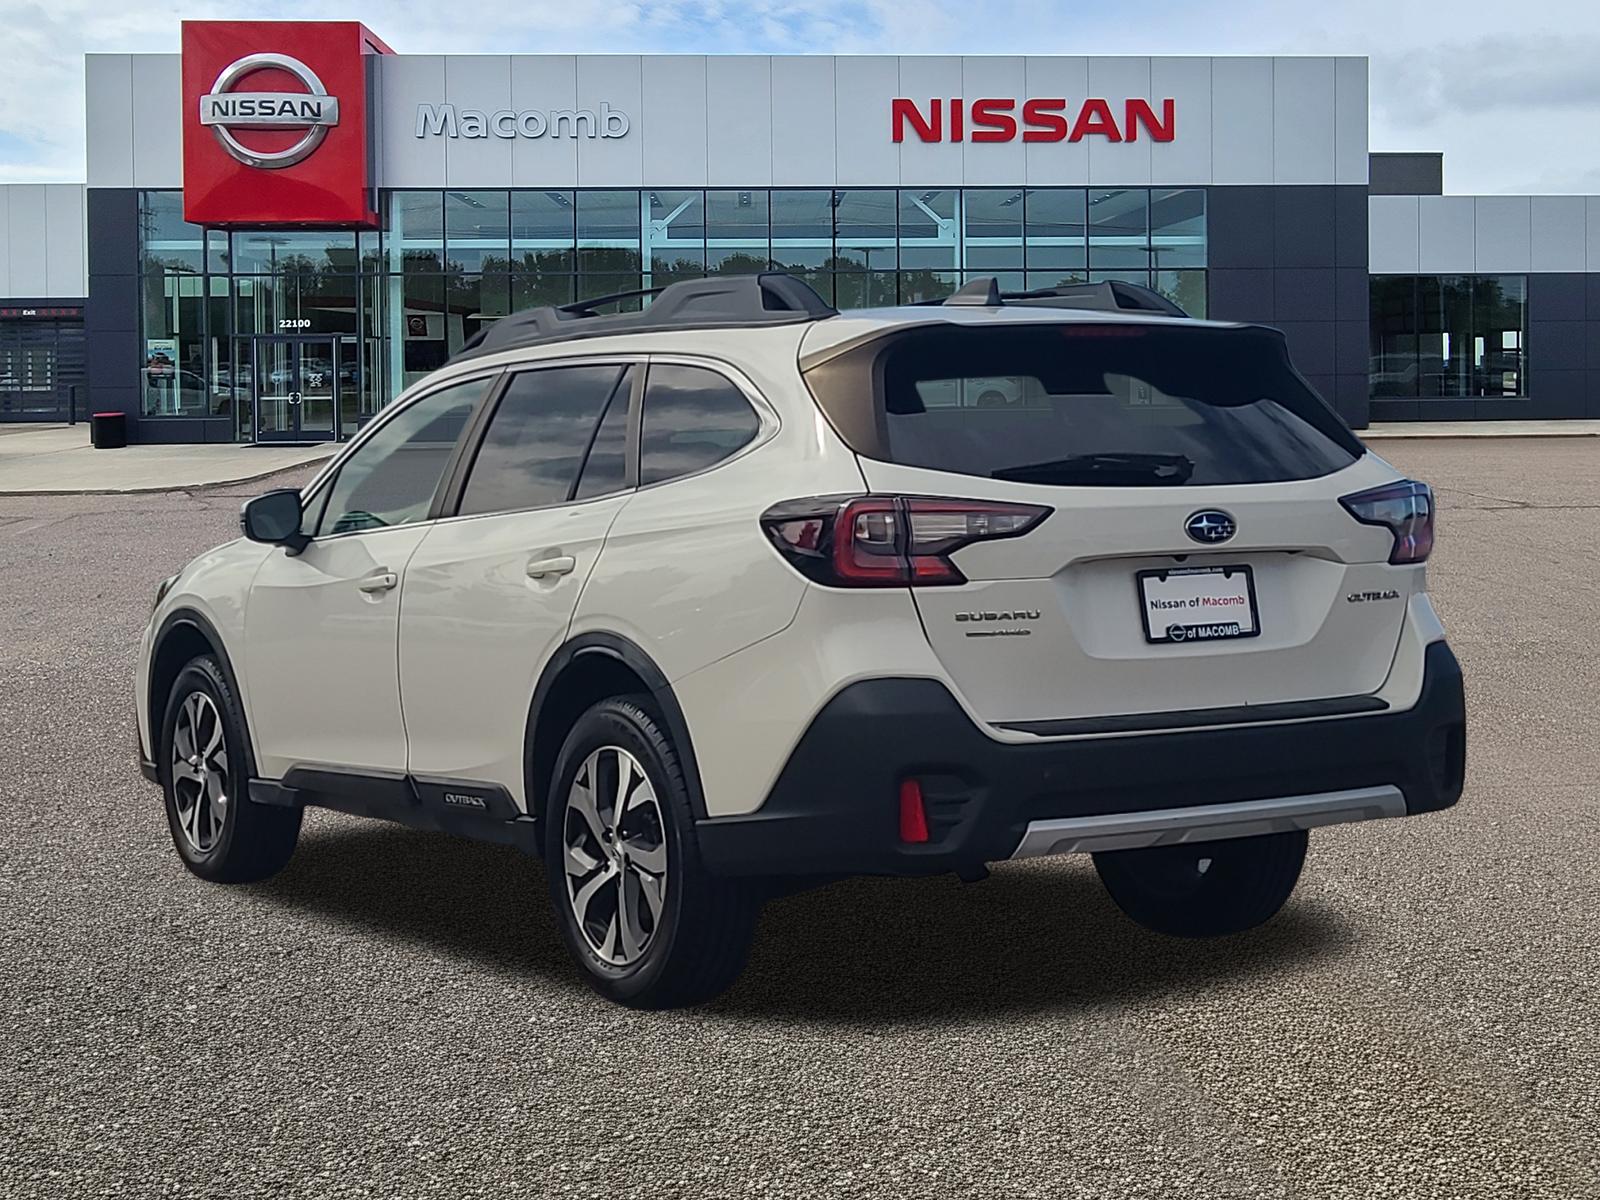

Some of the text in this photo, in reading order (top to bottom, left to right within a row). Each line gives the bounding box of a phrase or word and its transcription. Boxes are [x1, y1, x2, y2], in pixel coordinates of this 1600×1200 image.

[212, 100, 322, 118] NISSAN
[415, 102, 630, 139] Macomb
[892, 98, 1175, 143] NISSAN
[279, 319, 311, 328] 22100
[1150, 595, 1245, 610] Nissan of Macomb
[955, 609, 1040, 622] SUBARU
[1187, 624, 1240, 638] of MACOMB
[445, 793, 486, 808] OUTBACK
